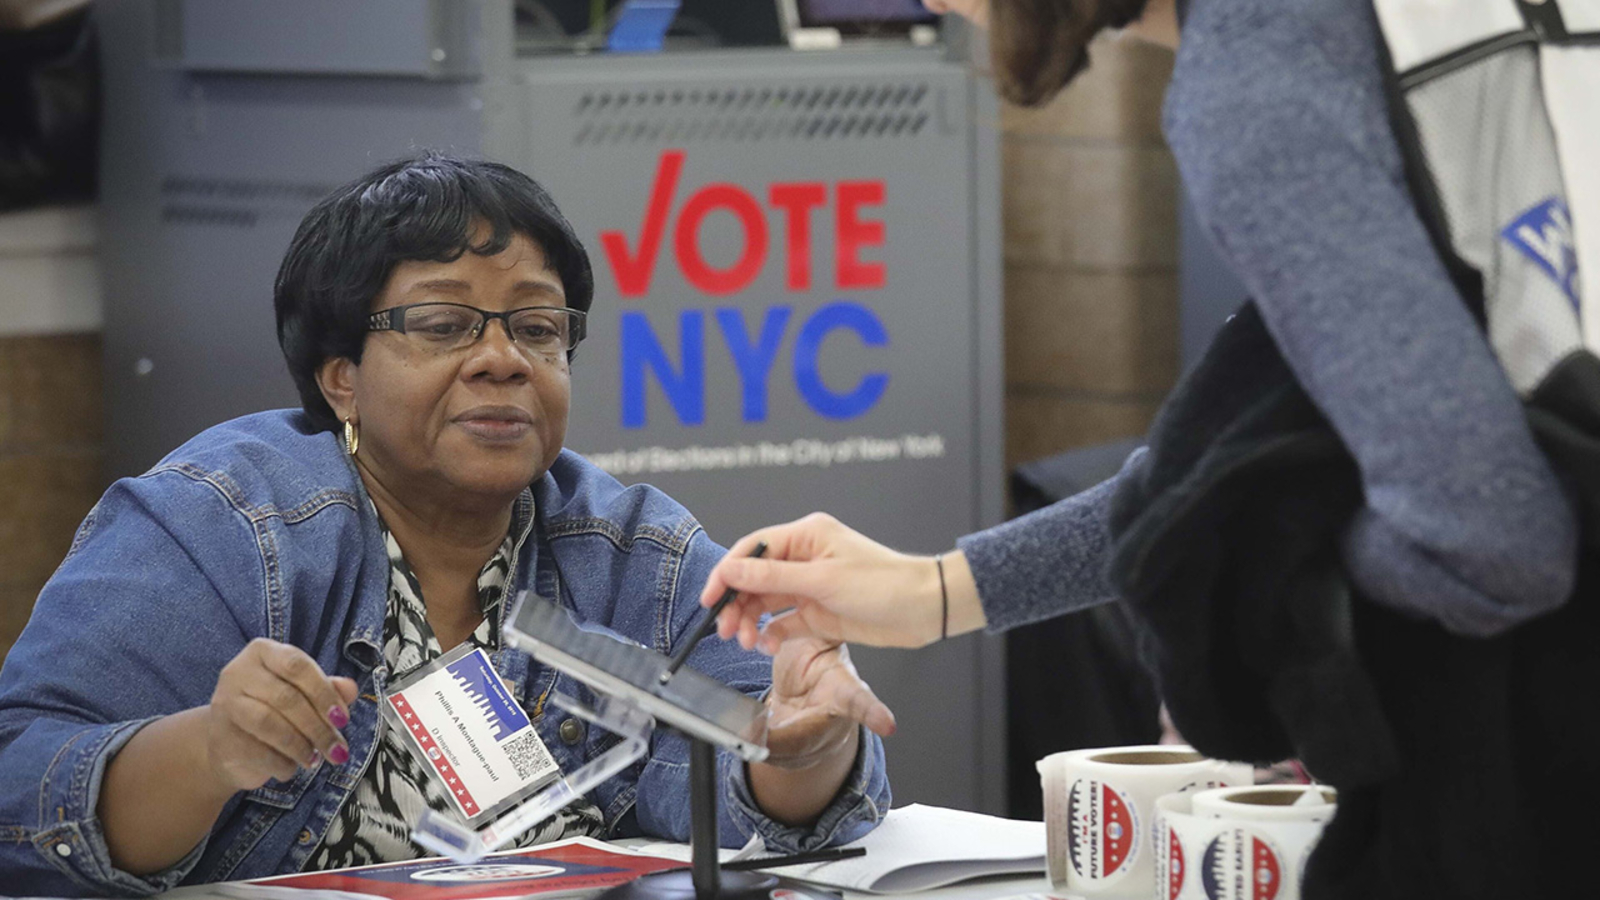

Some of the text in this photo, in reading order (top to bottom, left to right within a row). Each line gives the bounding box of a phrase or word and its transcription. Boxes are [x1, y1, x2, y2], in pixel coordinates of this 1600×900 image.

[601, 149, 887, 298] VOTE
[620, 301, 890, 428] NYC
[430, 726, 440, 736] D
[434, 690, 499, 783] Phillis A Montague-paul
[1090, 781, 1098, 880] FUTURE VOTER!
